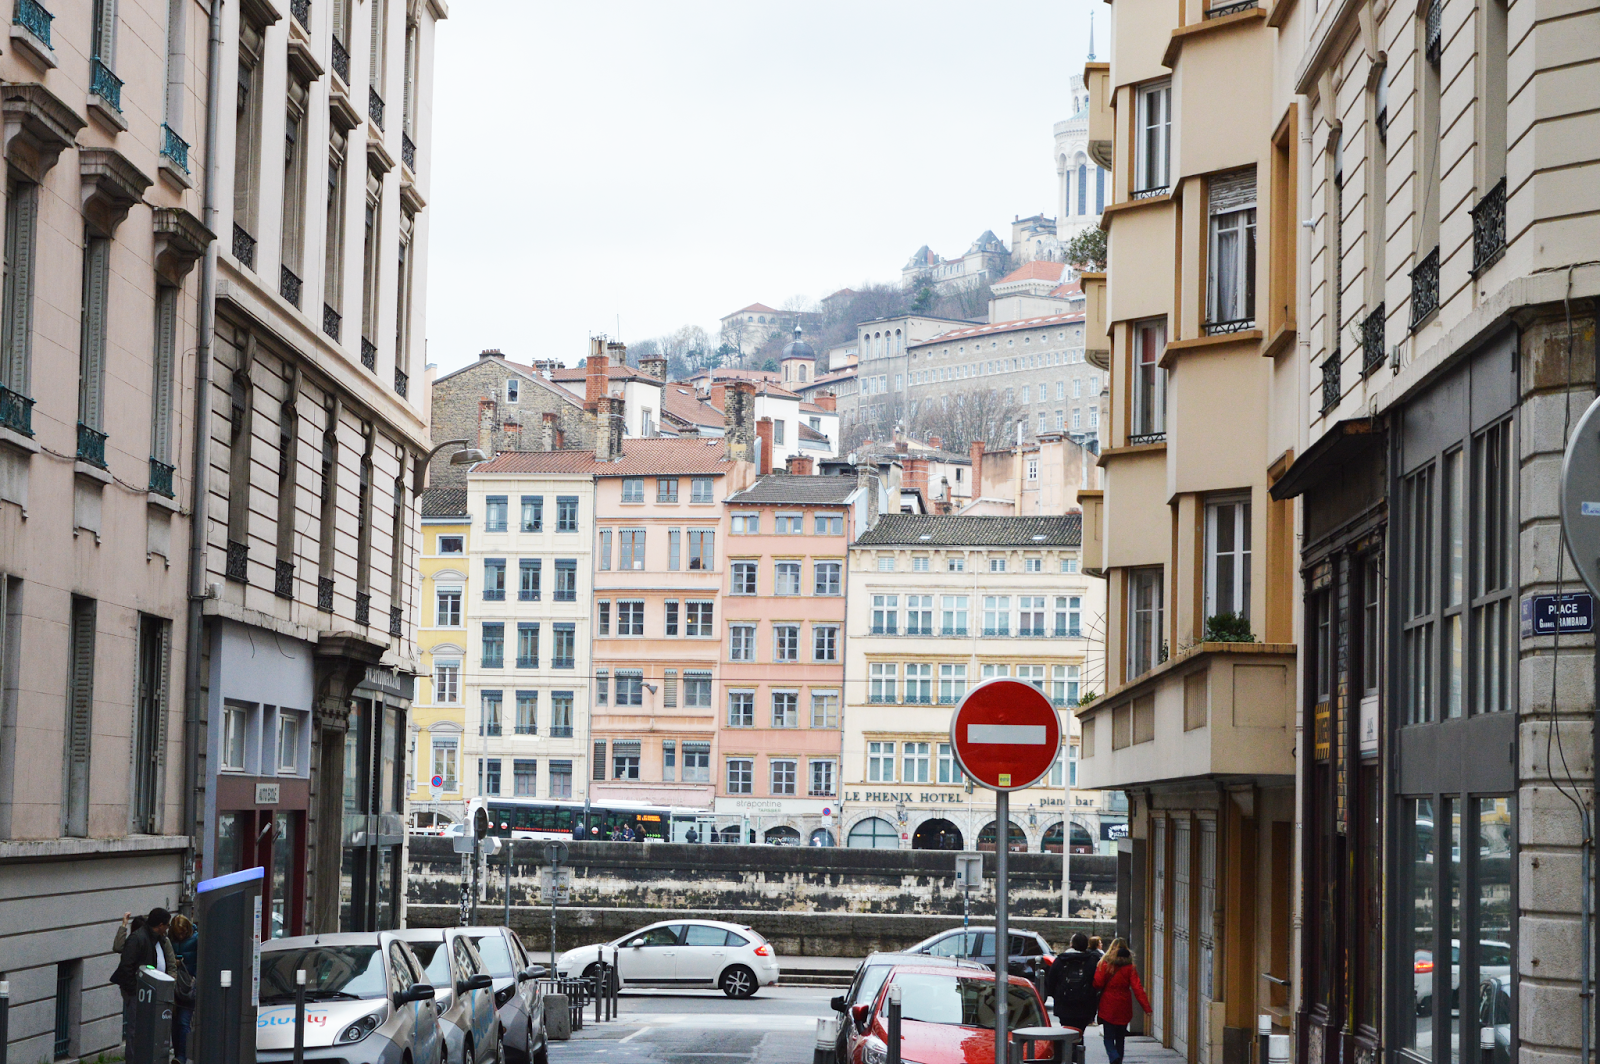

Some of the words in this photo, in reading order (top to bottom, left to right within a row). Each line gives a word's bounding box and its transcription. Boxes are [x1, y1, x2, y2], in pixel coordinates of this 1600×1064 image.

[1548, 603, 1578, 615] PLACE
[845, 791, 860, 801] LE
[865, 792, 913, 802] PHENIX
[919, 793, 963, 803] HOTEL
[1075, 796, 1094, 806] bar
[736, 799, 782, 809] strapontine
[138, 988, 152, 1003] 01
